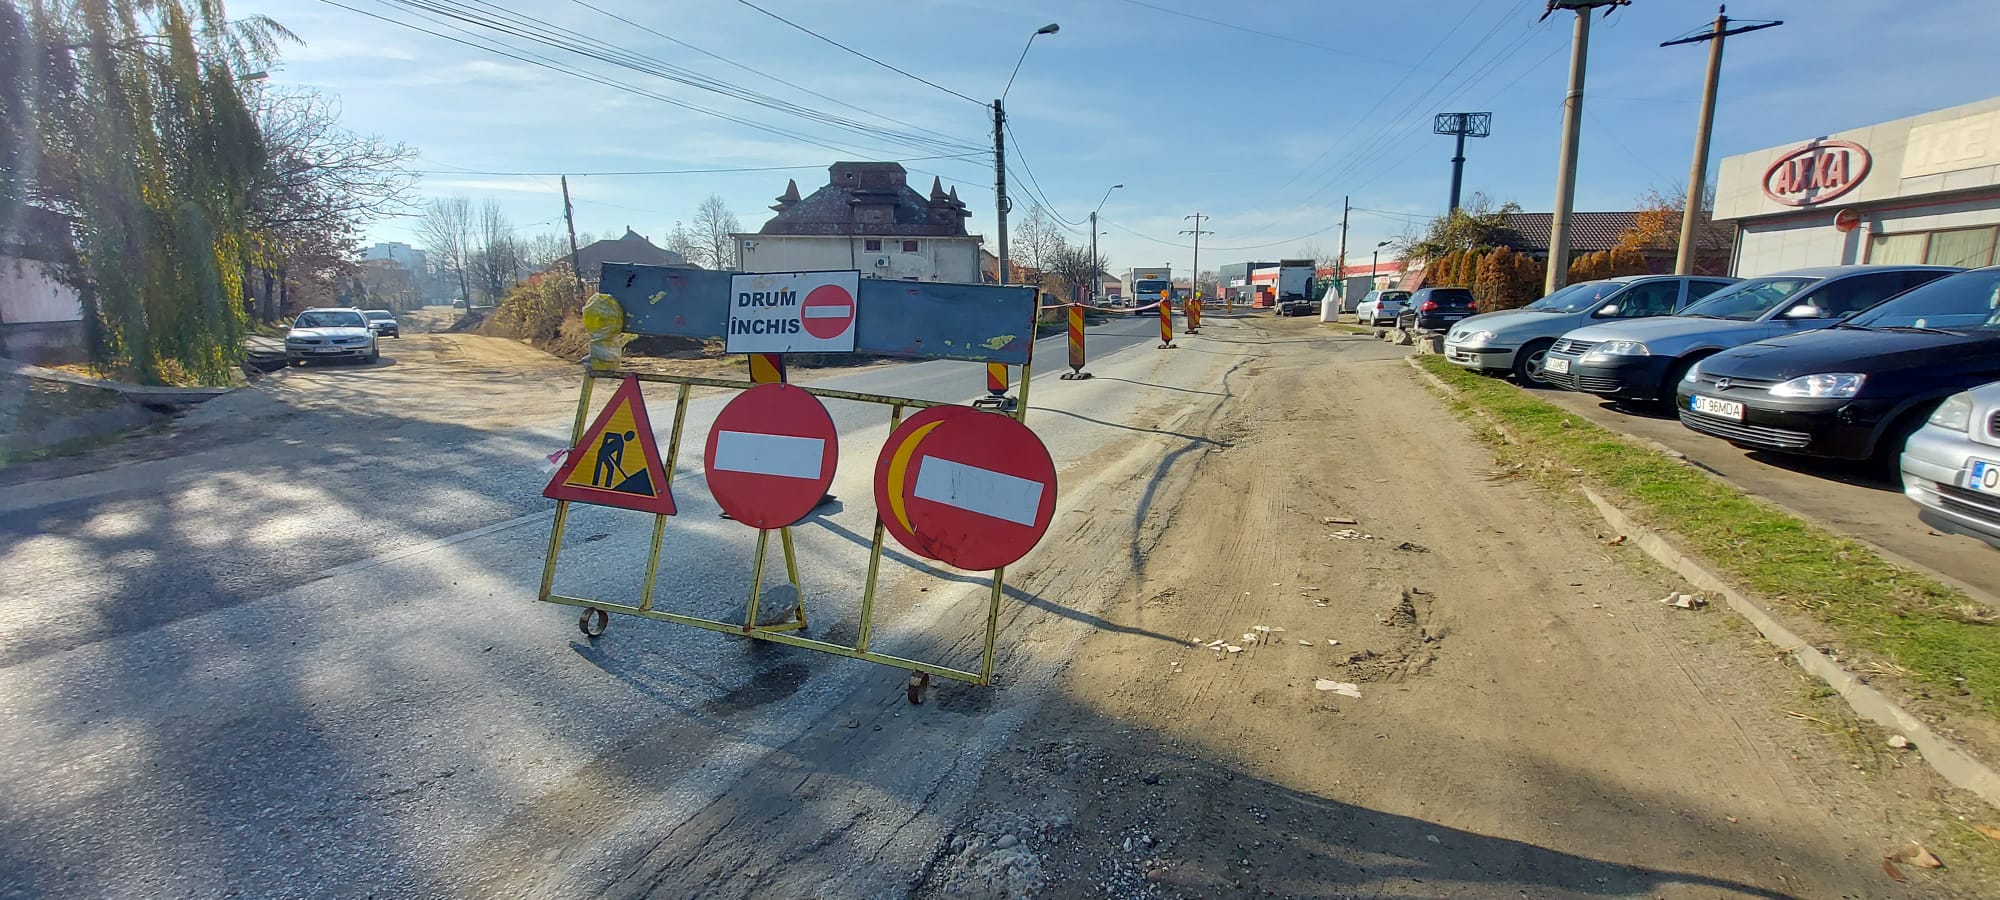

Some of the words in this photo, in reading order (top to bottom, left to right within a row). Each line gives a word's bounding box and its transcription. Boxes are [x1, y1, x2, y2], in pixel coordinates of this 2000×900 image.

[739, 291, 796, 307] DRUM
[731, 317, 800, 334] ÎNCHIS
[1696, 398, 1706, 409] OT
[1709, 400, 1740, 416] 96MDA
